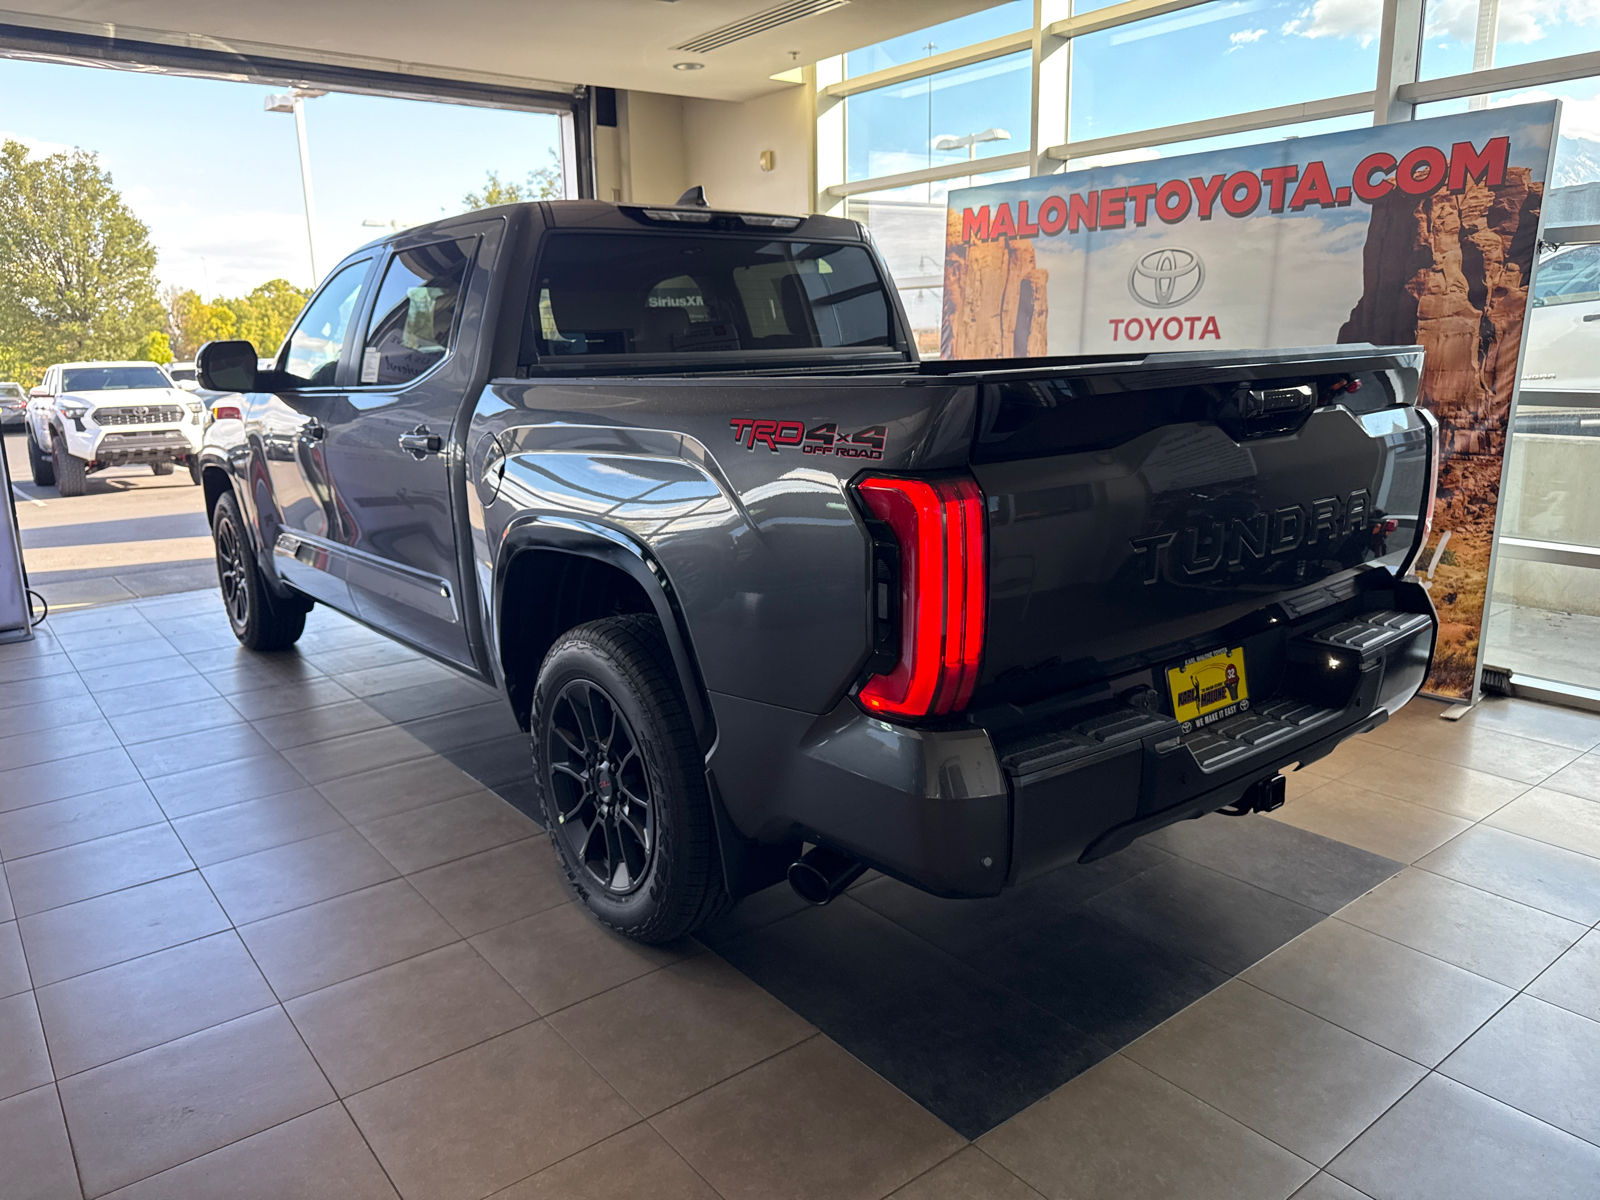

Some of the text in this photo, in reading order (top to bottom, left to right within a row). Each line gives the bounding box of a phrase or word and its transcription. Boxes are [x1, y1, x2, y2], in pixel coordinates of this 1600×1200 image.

[962, 136, 1511, 244] MALONETOYOTA.COM
[1108, 316, 1221, 341] TOYOTA
[730, 418, 888, 454] TRD 4x4
[803, 445, 884, 461] OFF ROAD
[1128, 488, 1372, 585] TUNDRA
[1227, 668, 1236, 679] 32
[1178, 688, 1196, 708] KARL
[1201, 685, 1228, 708] MALONE
[1195, 705, 1238, 728] WE MAKE IT EASY
